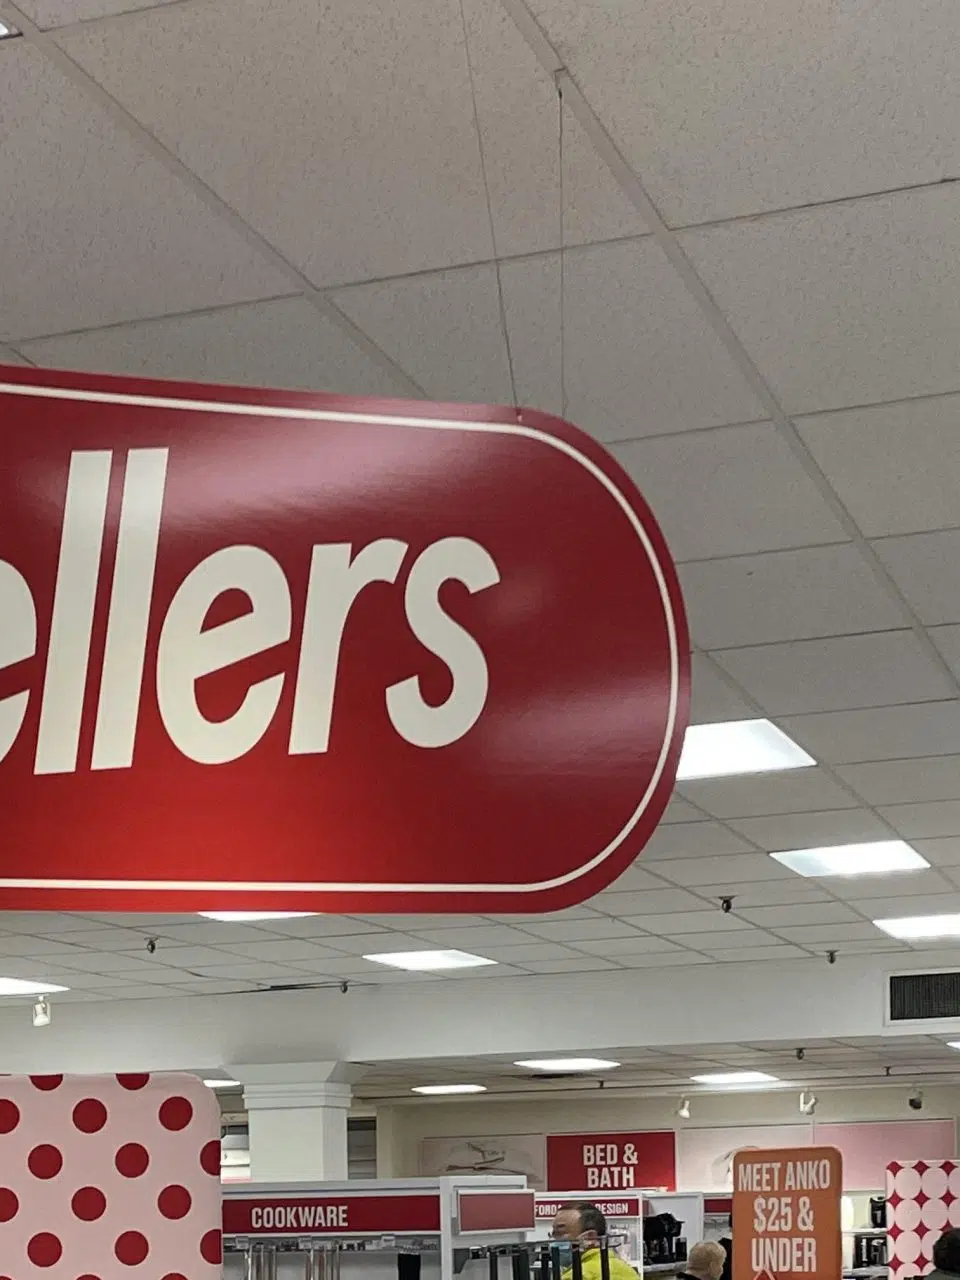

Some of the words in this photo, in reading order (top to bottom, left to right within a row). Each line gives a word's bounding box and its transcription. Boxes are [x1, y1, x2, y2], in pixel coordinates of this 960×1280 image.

[583, 1144, 618, 1165] BED
[623, 1143, 638, 1164] &
[587, 1167, 634, 1188] BATH
[739, 1162, 780, 1192] MEET
[784, 1160, 830, 1190] ANKO
[252, 1206, 348, 1228] COOKWARE
[754, 1196, 791, 1232] $25
[797, 1196, 814, 1231] &
[752, 1238, 816, 1273] UNDER
